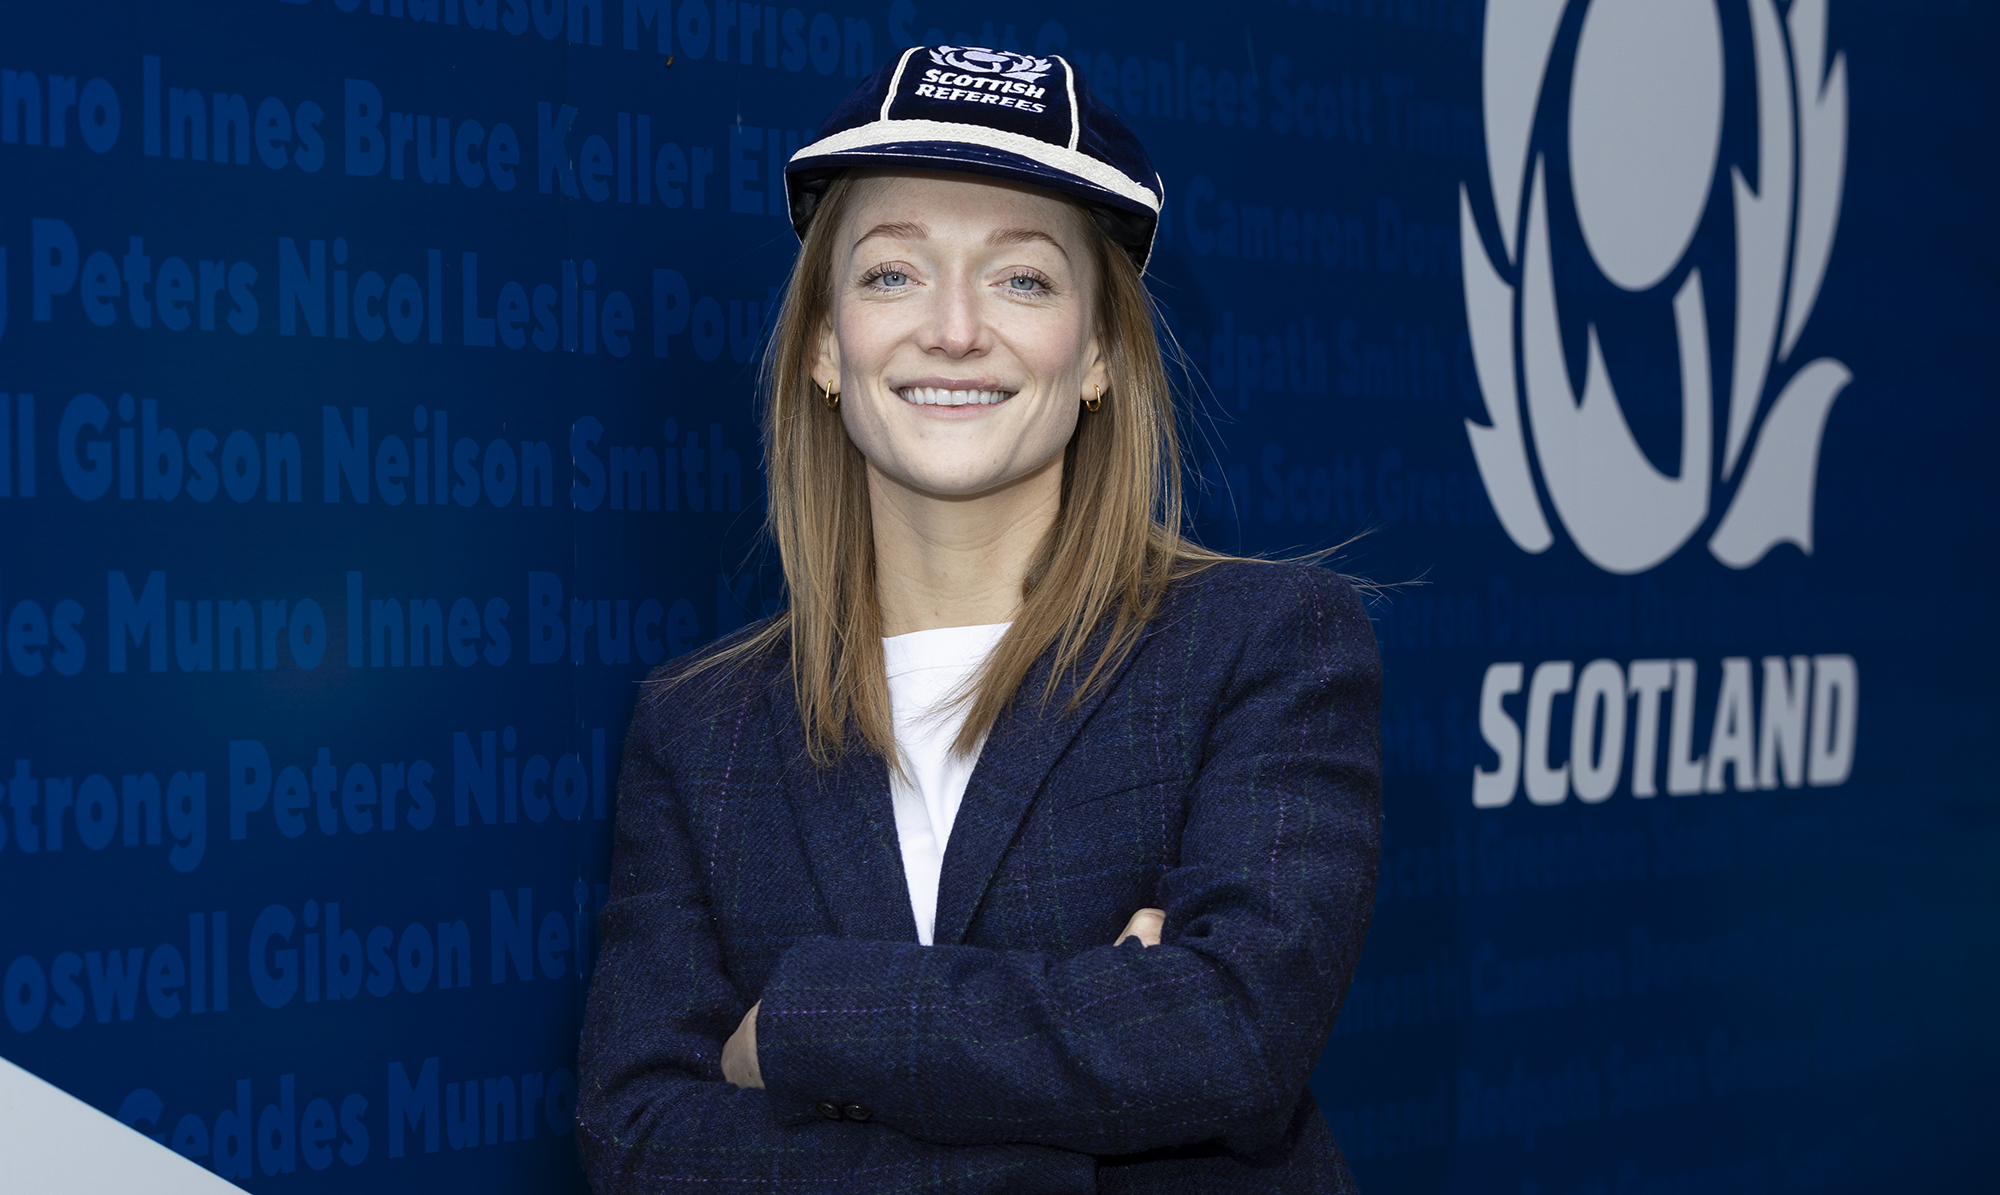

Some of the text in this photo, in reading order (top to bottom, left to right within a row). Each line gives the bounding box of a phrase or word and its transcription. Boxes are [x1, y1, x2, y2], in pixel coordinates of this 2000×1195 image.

[622, 0, 874, 79] Morrison
[922, 68, 1046, 99] SCOTTISH
[143, 55, 325, 173] Innes
[343, 78, 520, 192] Bruce
[536, 101, 714, 210] Keller
[729, 123, 815, 217] El
[915, 83, 1047, 114] REFEREES
[1269, 53, 1374, 146] Scott
[1381, 71, 1480, 158] Timm
[1184, 173, 1367, 271] Cameron
[31, 216, 259, 335] Peters
[278, 237, 443, 345] Nicol
[462, 251, 635, 358] Leslie
[1160, 302, 1328, 412] edpath
[1337, 317, 1448, 401] Smith
[57, 391, 303, 504] Gibson
[322, 404, 554, 509] Neilson
[570, 415, 742, 513] Smith
[1261, 441, 1367, 524] Scott
[0, 598, 86, 677] es
[106, 569, 327, 674] Munro
[346, 569, 511, 669] Innes
[528, 570, 698, 666] Bruce
[1472, 653, 1858, 809] SCOTLAND
[0, 725, 608, 873] trong Peters Nicol
[248, 898, 472, 1010] Gibson
[489, 877, 609, 985] Nei
[387, 1056, 577, 1160] Munro
